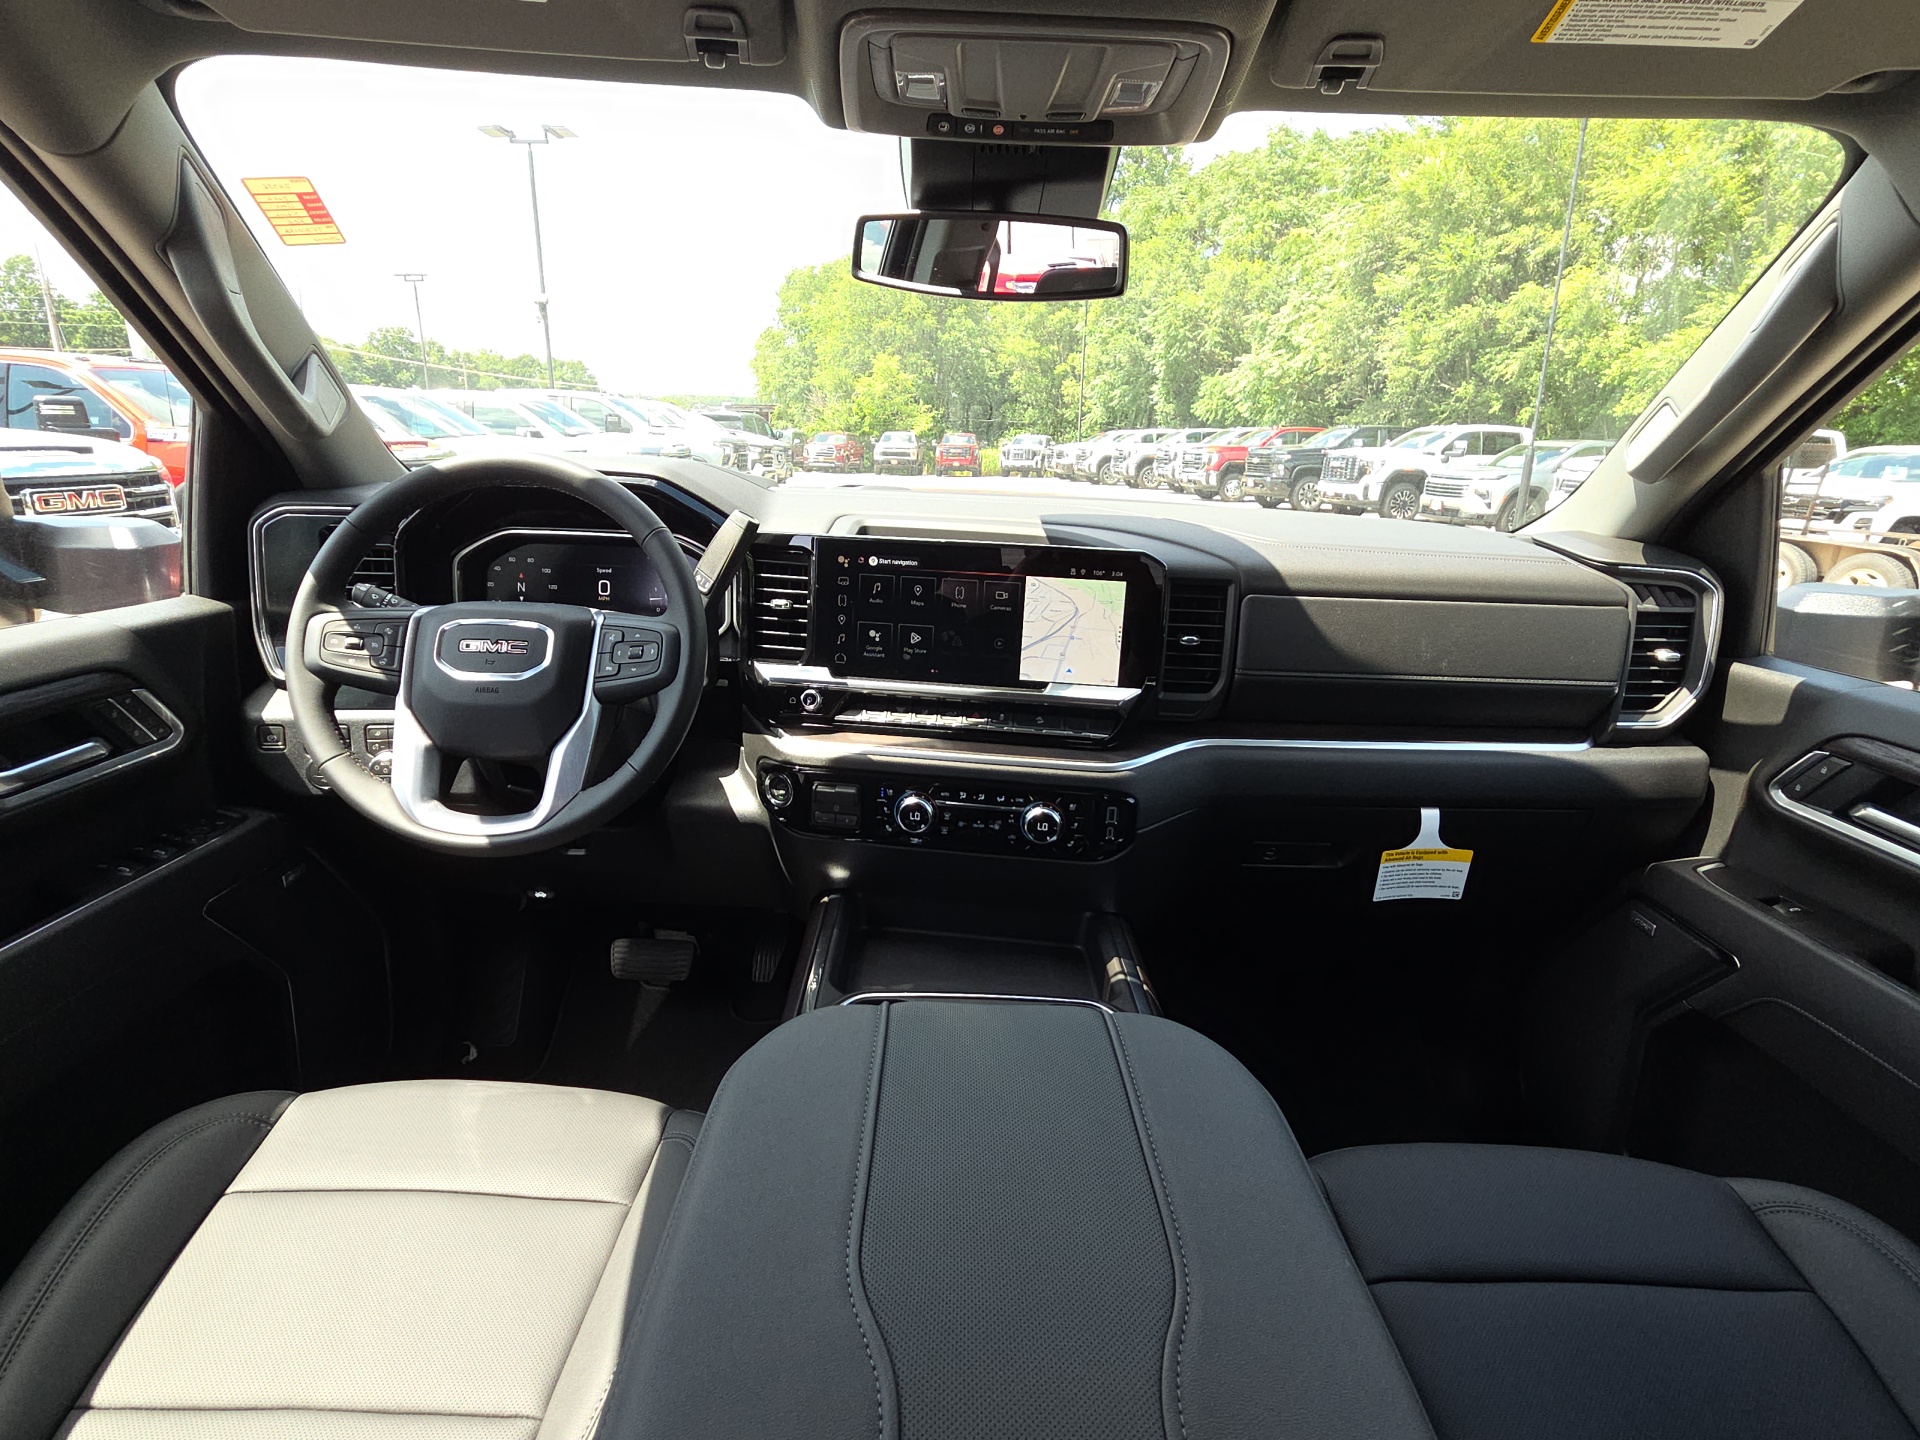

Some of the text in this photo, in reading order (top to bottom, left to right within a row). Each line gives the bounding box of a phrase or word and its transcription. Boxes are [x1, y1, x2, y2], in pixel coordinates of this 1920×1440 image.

[35, 488, 123, 513] GMC
[517, 582, 525, 592] N
[598, 580, 610, 595] 0
[460, 639, 528, 654] GMC
[475, 686, 499, 694] AIRBAG
